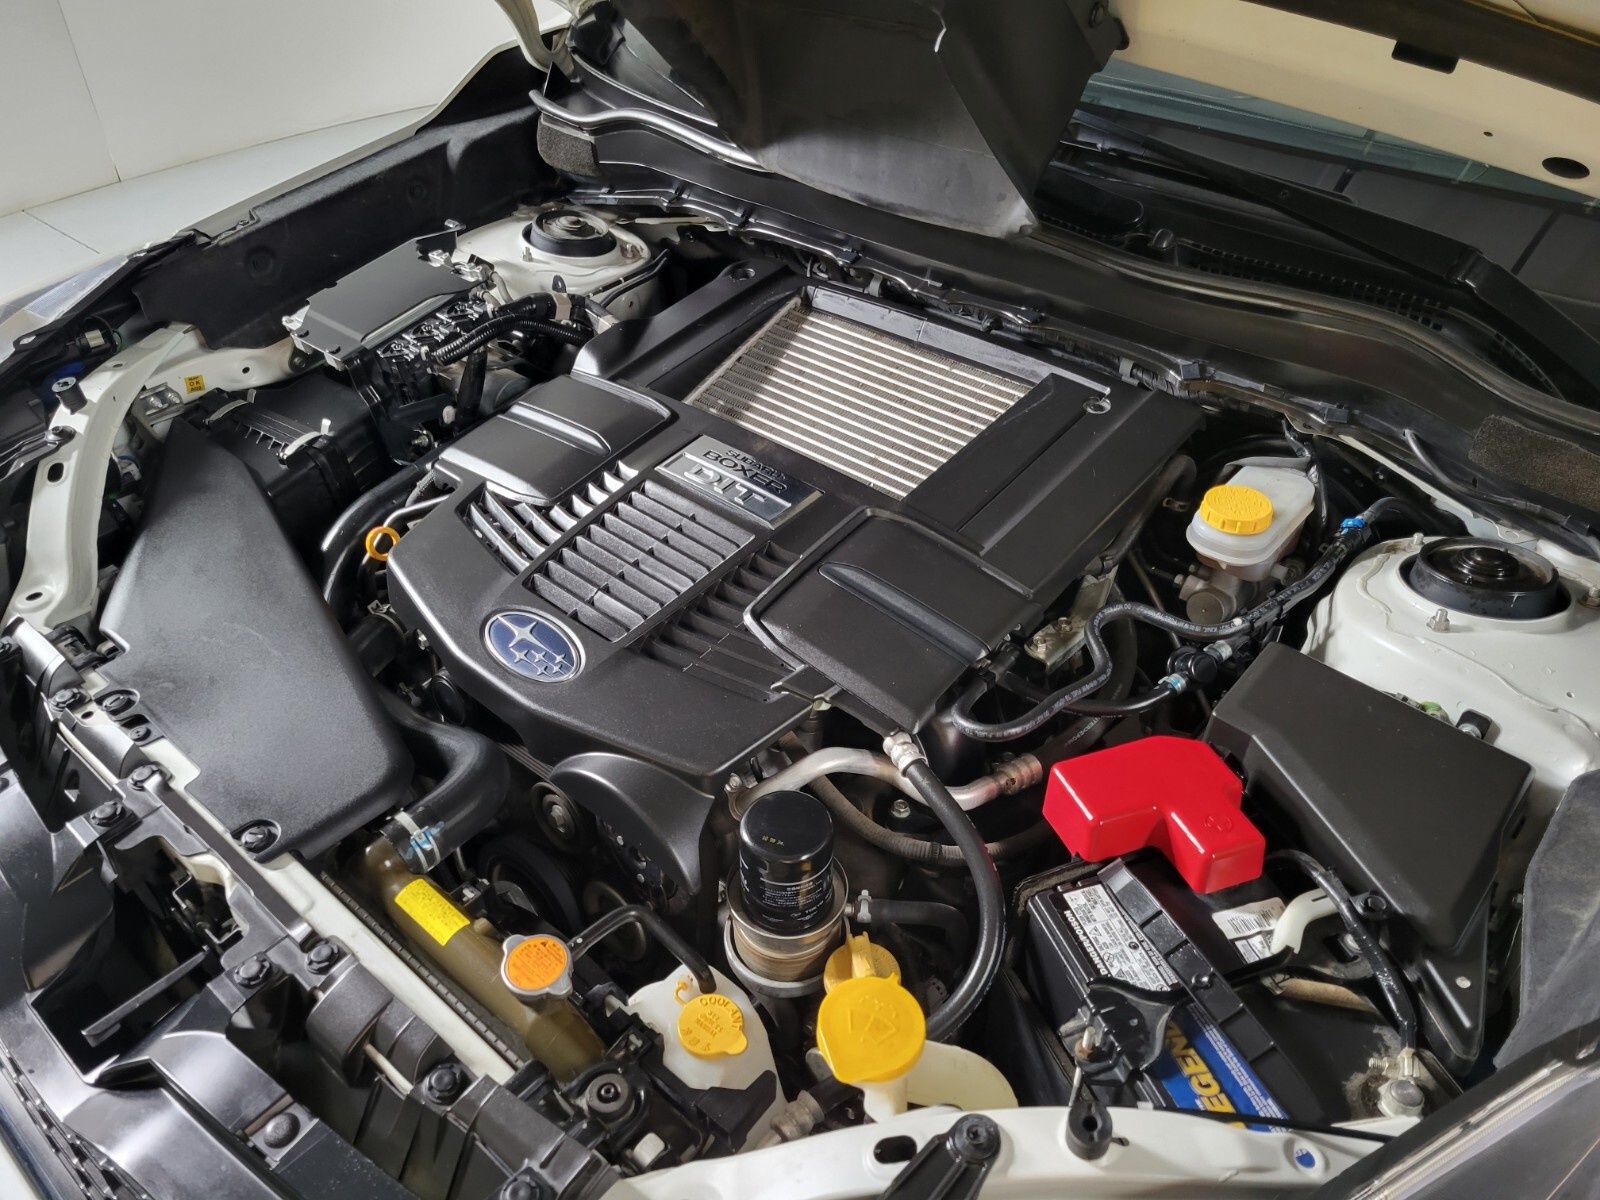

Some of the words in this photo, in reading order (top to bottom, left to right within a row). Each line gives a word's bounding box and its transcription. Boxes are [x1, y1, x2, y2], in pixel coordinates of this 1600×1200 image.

[703, 450, 788, 494] BOXER
[726, 449, 786, 480] SUBARU
[683, 464, 767, 504] DIT
[699, 996, 743, 1032] COOLANT
